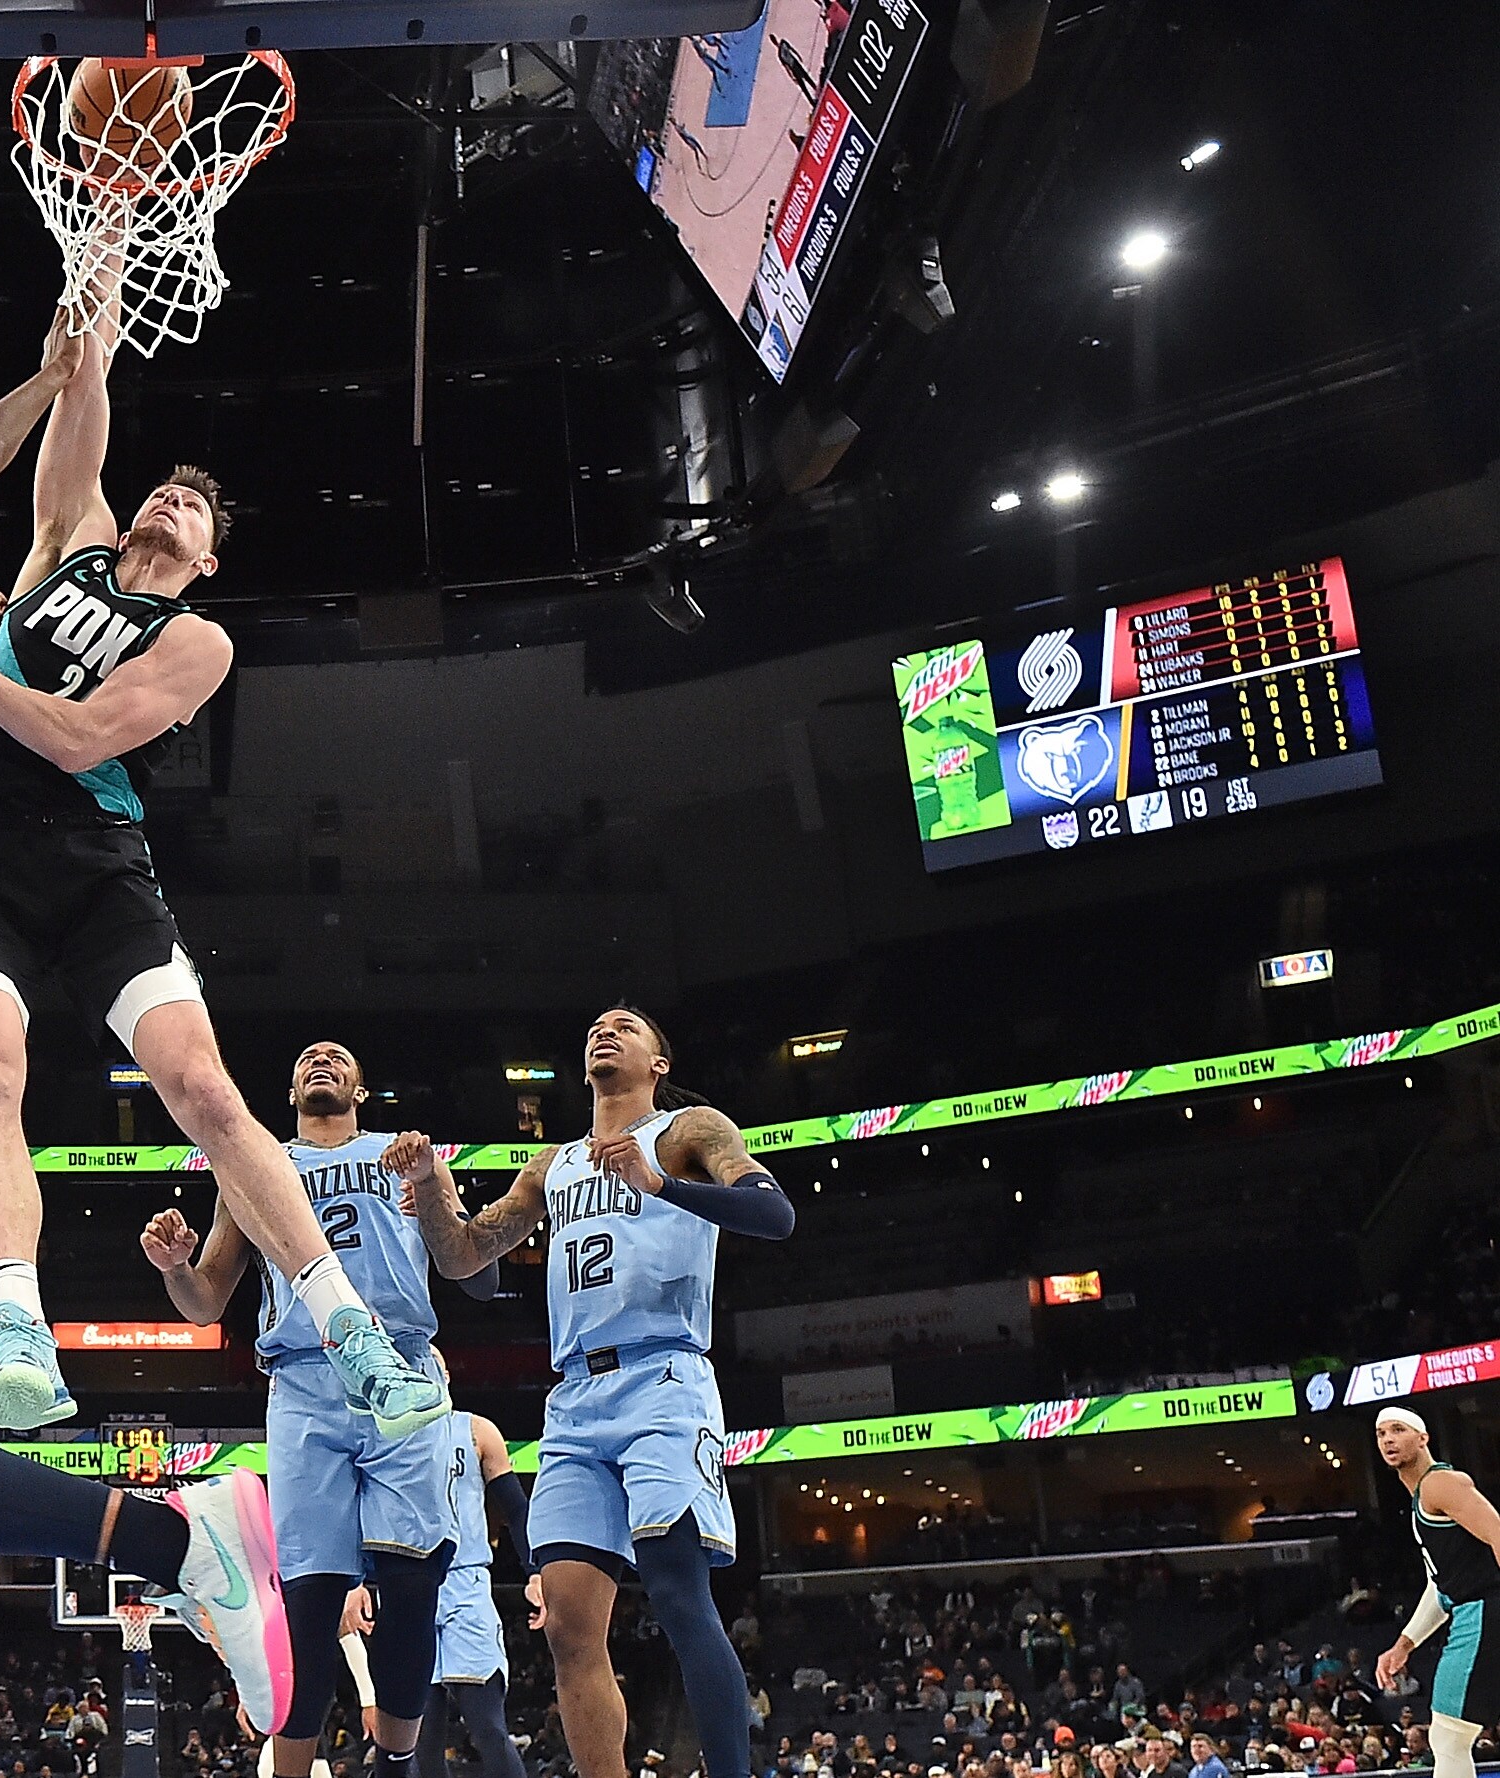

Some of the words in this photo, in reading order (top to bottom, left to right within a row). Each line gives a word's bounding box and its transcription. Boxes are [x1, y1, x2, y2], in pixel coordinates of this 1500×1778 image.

[847, 19, 894, 105] 11:02
[777, 182, 811, 249] TIMEOUTS:
[799, 170, 814, 189] 5
[808, 115, 836, 165] FOULS:
[825, 101, 840, 121] 0
[800, 217, 835, 282] TIMEOUTS:
[824, 203, 839, 223] 5
[833, 148, 861, 199] FOULS:
[850, 135, 865, 155] 0
[760, 251, 786, 296] 54
[782, 286, 808, 325] 61
[23, 580, 142, 680] PDX
[1134, 616, 1144, 631] 0
[1145, 605, 1189, 628] LILLARD
[1138, 632, 1145, 646] 1
[1148, 622, 1192, 643] SIMONS
[1221, 611, 1235, 627] 10
[1252, 605, 1262, 619] 0
[1138, 647, 1148, 661] 11
[1151, 640, 1179, 658] HART
[1226, 627, 1236, 642] 0
[1153, 651, 1205, 675] EUBANKS
[1287, 630, 1297, 645] 0
[1156, 668, 1202, 690] WALKER
[1232, 659, 1242, 673] 0
[1260, 652, 1271, 667] 0
[1290, 646, 1300, 661] 0
[1319, 639, 1330, 654] 0
[1151, 724, 1163, 740] 12
[1165, 714, 1211, 736] MORANT
[1240, 706, 1251, 721] 11
[1328, 687, 1339, 702] 0
[1162, 699, 1209, 721] TILLMAN
[1265, 683, 1279, 699] 10
[1168, 729, 1217, 751] JACKSON
[1218, 727, 1232, 743] JR
[1241, 721, 1256, 737] 10
[1170, 751, 1200, 768] BANE
[1173, 763, 1219, 784] BROOKS
[1227, 777, 1251, 796] 1ST
[1088, 804, 1121, 838] 22
[1181, 787, 1209, 819] 19
[1225, 791, 1257, 814] 2:59
[1456, 1019, 1478, 1039] DO
[1195, 1066, 1216, 1082] DO
[1239, 1056, 1275, 1075] DEW
[953, 1102, 973, 1118] DO
[994, 1093, 1027, 1112] DEW
[762, 1128, 794, 1147] DEW
[68, 1152, 87, 1166] DO
[88, 1156, 106, 1167] THE
[106, 1152, 138, 1166] DEW
[509, 1149, 529, 1165] DO
[300, 1159, 391, 1202] RIZZLIES
[321, 1203, 362, 1250] 2
[565, 1233, 614, 1294] 12
[1425, 1347, 1484, 1371] TIMEOUTS:
[1485, 1344, 1495, 1360] 5
[1370, 1363, 1400, 1396] 54
[1427, 1369, 1467, 1389] FOULS:
[1468, 1365, 1477, 1381] 0
[1164, 1399, 1191, 1418] DO
[1218, 1391, 1264, 1414] DEW
[116, 1429, 165, 1448] 11:01
[843, 1429, 867, 1447] DO
[893, 1422, 933, 1443] DEW
[43, 1455, 65, 1469] THE
[65, 1452, 100, 1468] DEW
